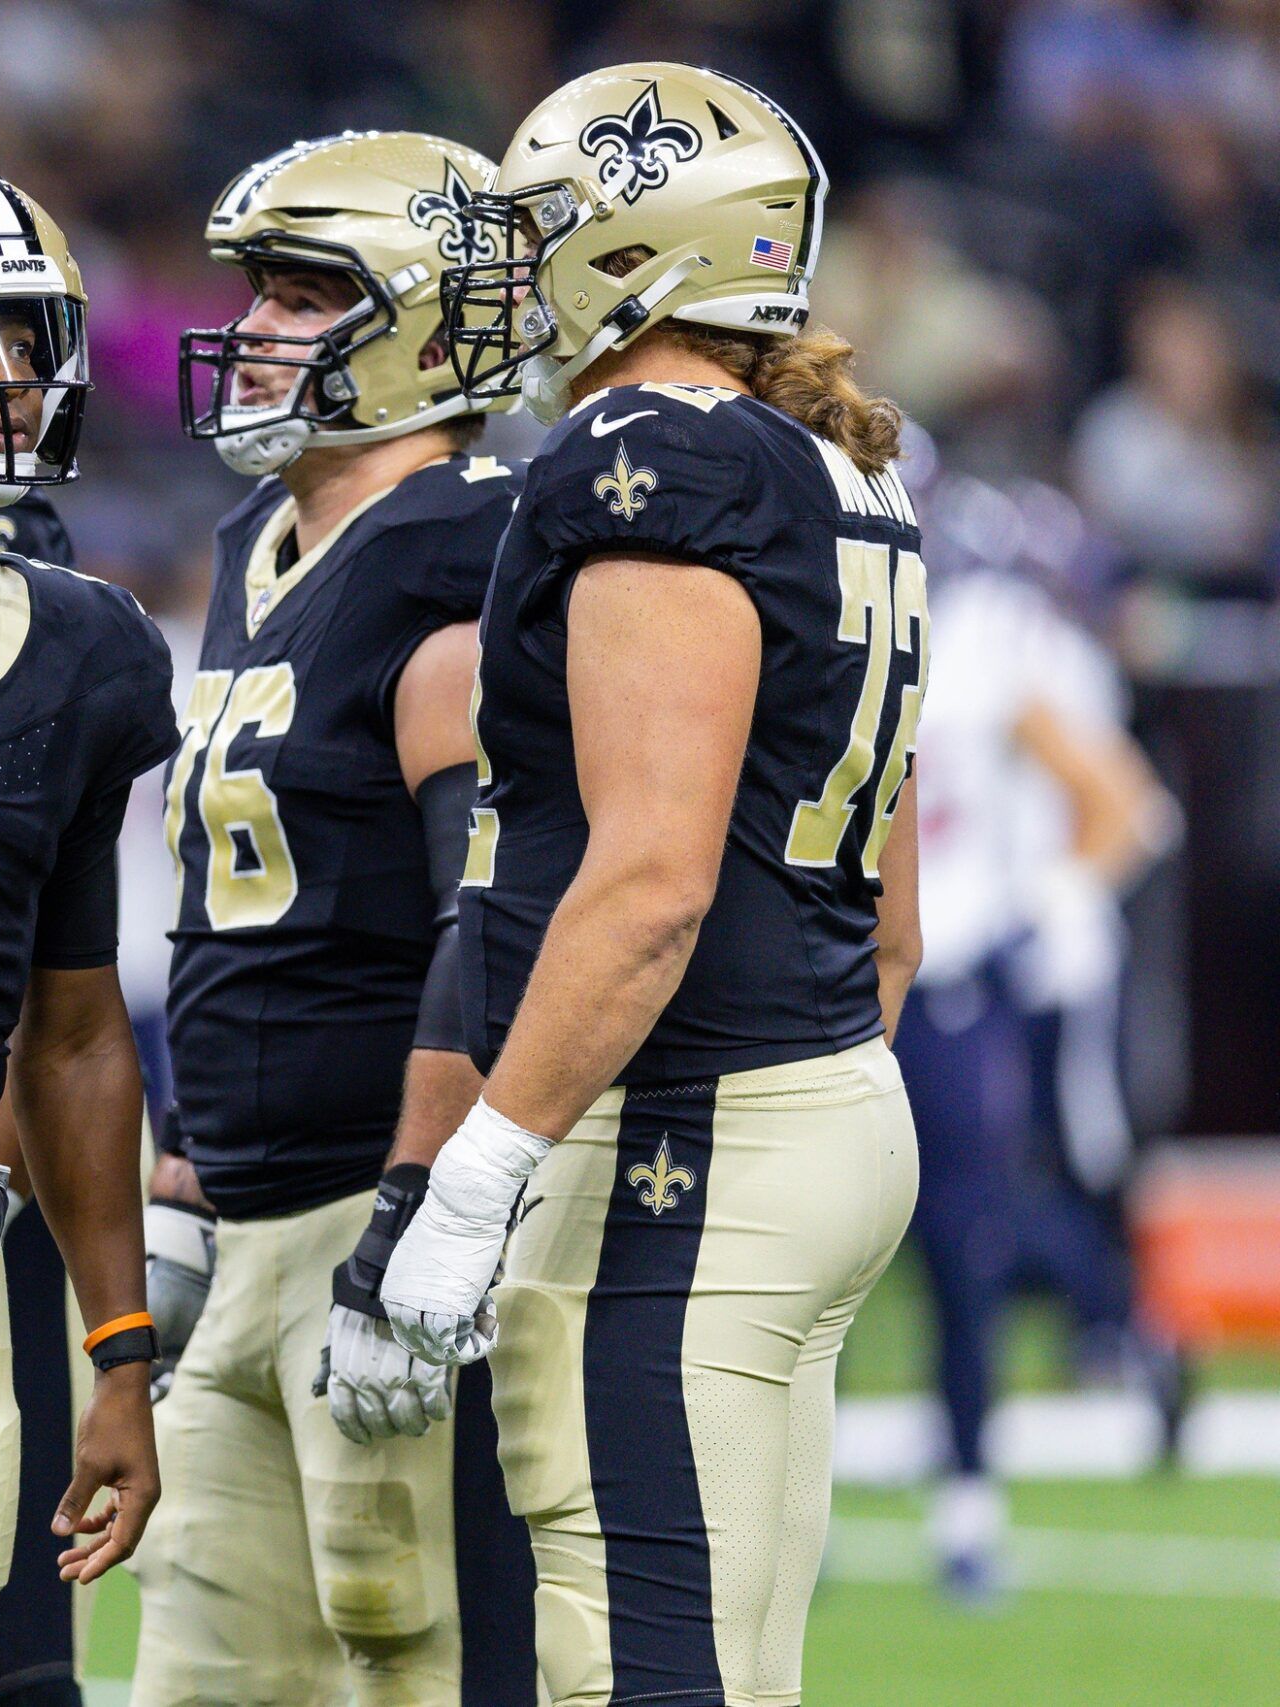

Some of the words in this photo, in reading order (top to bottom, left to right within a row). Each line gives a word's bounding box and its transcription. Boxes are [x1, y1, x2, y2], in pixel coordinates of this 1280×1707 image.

[1, 259, 47, 272] SAINTS
[163, 661, 299, 932] 76
[784, 536, 932, 879] 72
